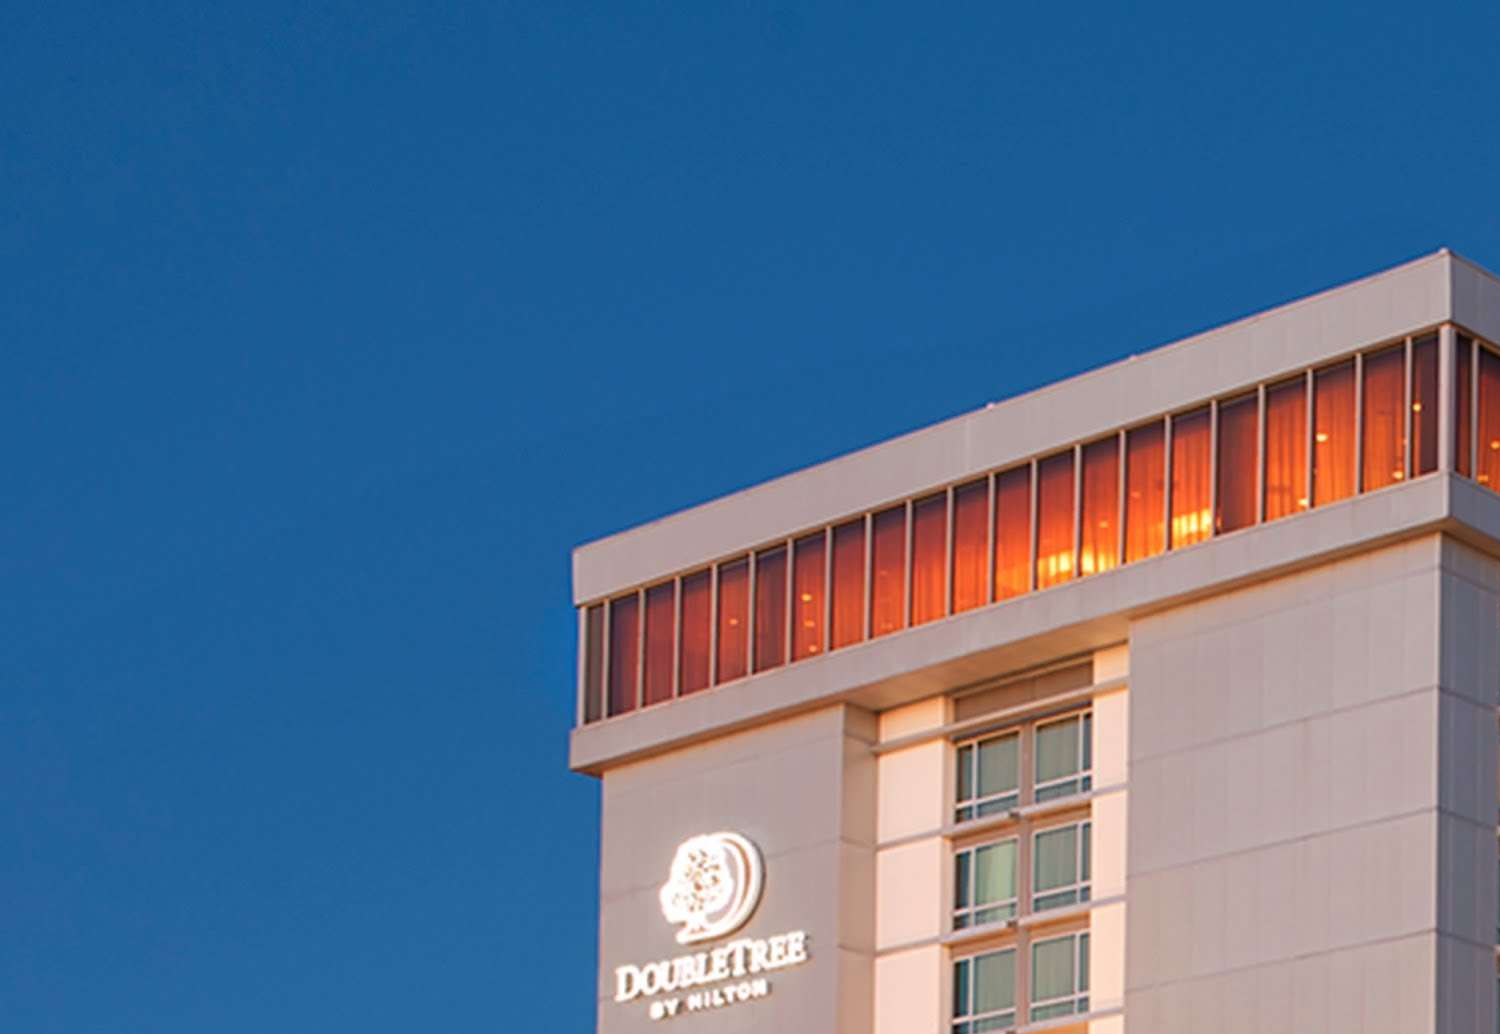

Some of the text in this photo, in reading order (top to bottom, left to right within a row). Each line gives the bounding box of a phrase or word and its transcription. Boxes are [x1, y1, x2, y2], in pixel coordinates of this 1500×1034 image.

[615, 930, 808, 1001] DOUBLETREE
[649, 978, 768, 1020] BY HILTON
